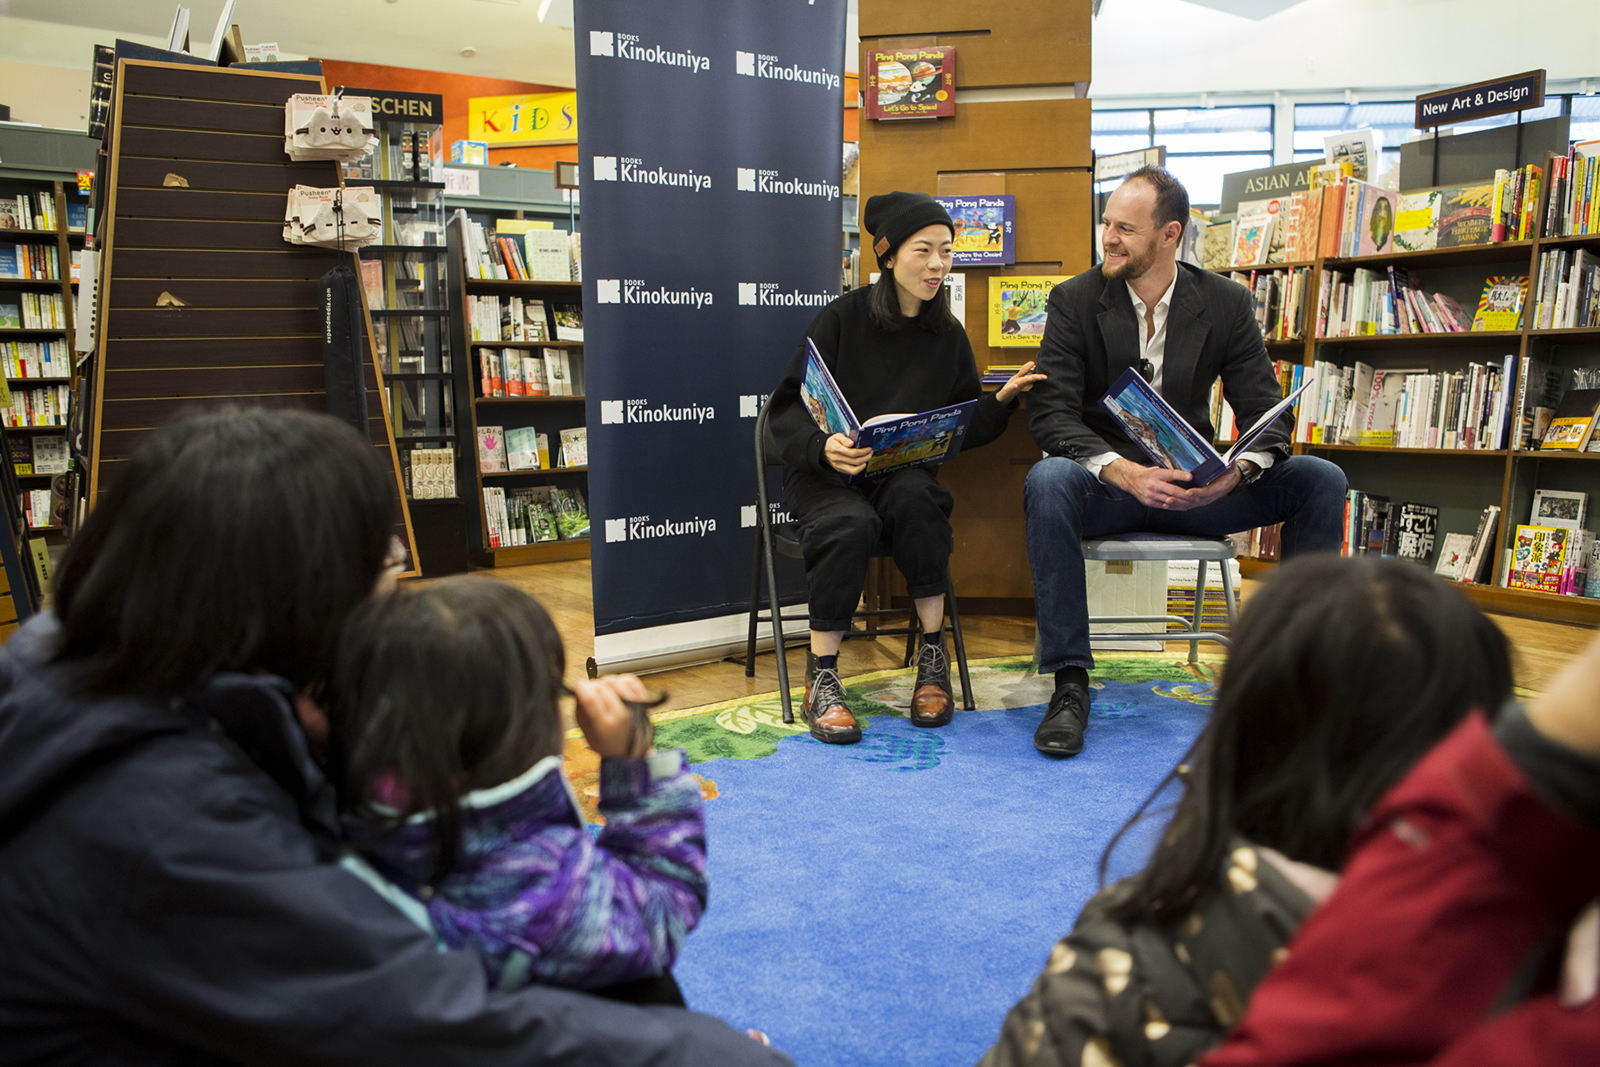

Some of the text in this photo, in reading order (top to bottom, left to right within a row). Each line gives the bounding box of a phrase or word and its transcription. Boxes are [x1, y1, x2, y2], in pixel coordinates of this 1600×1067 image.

[617, 33, 640, 42] BOOKS
[617, 40, 710, 73] Kinokuniya
[757, 54, 779, 62] BOOKS
[875, 51, 944, 62] Ping Pong Panda
[757, 60, 840, 90] Kinokuniya
[371, 97, 433, 117] SCHEN
[1423, 86, 1529, 116] New Art & Design
[620, 157, 643, 165] BOOKS
[620, 164, 712, 193] Kinokuniya
[758, 176, 840, 202] Kinokuniya
[1245, 172, 1291, 194] ASIAN
[955, 199, 977, 208] Pong
[979, 198, 1005, 207] Panda
[1451, 225, 1489, 235] HERITAGE
[1456, 218, 1485, 227] WORLD
[1458, 233, 1480, 242] JAPAN
[1000, 281, 1018, 289] Ping
[1020, 281, 1042, 289] Pong
[624, 285, 713, 309] Kinokuniya
[1371, 371, 1385, 401] 100%
[627, 403, 715, 425] Kinokuniya
[872, 408, 963, 436] Ping Pong Panda
[629, 516, 716, 540] Kinokuniya
